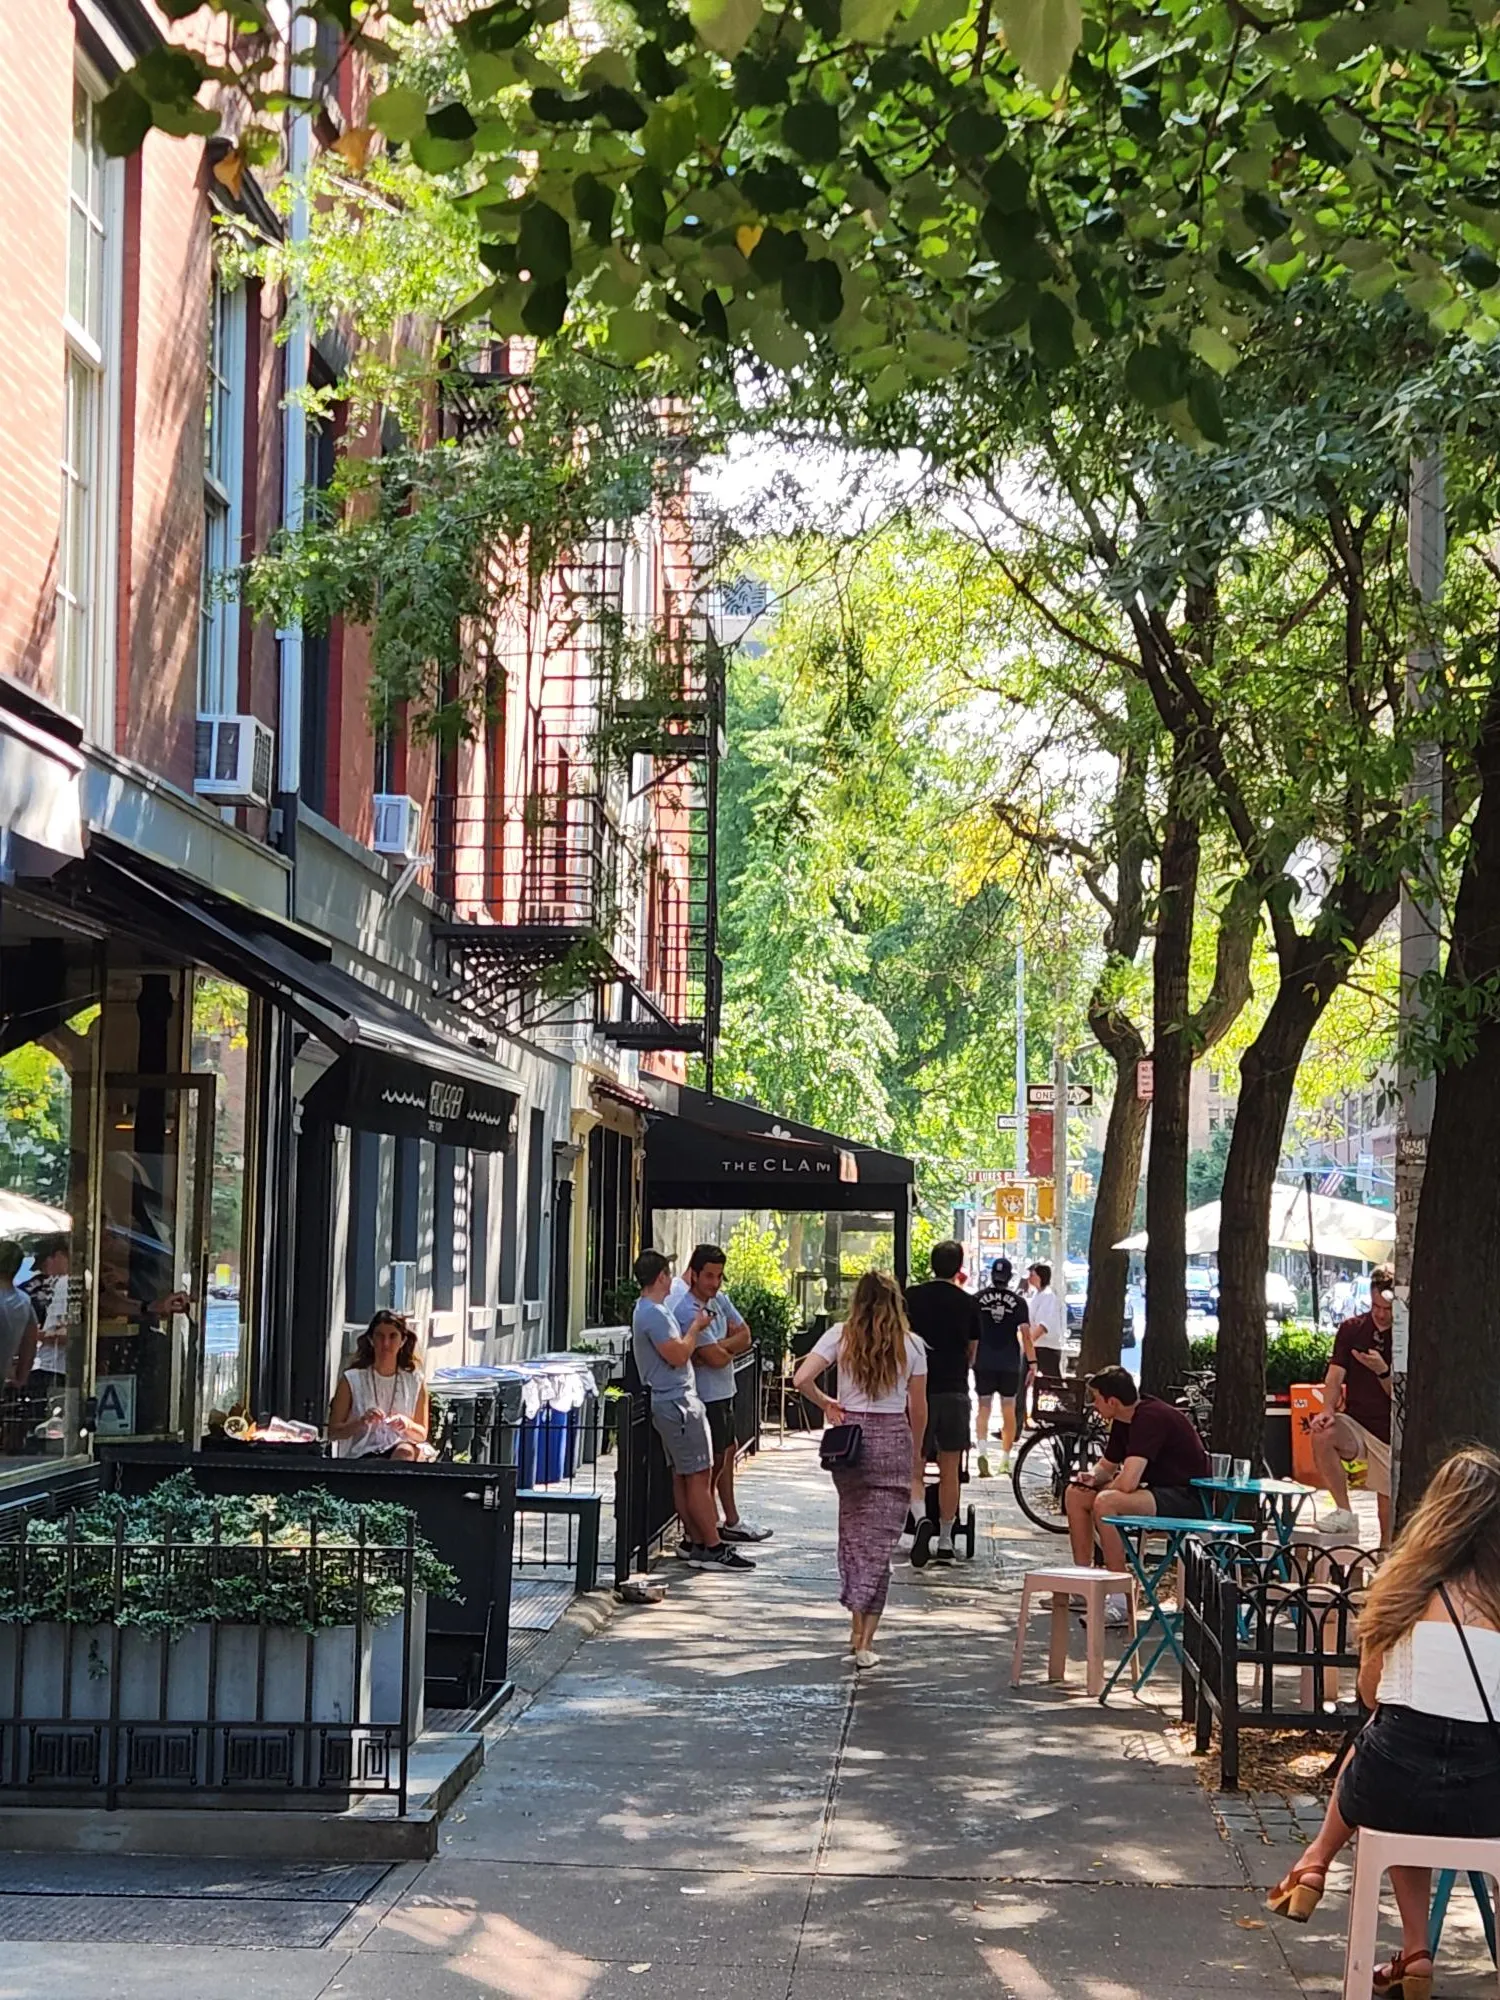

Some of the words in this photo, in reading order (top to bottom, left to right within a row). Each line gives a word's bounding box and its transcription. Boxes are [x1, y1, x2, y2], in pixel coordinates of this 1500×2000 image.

[1035, 1091, 1054, 1100] ONE
[721, 1161, 757, 1172] THE
[763, 1158, 831, 1173] CLAM
[979, 1293, 1002, 1305] TEAM
[98, 1384, 125, 1420] A
